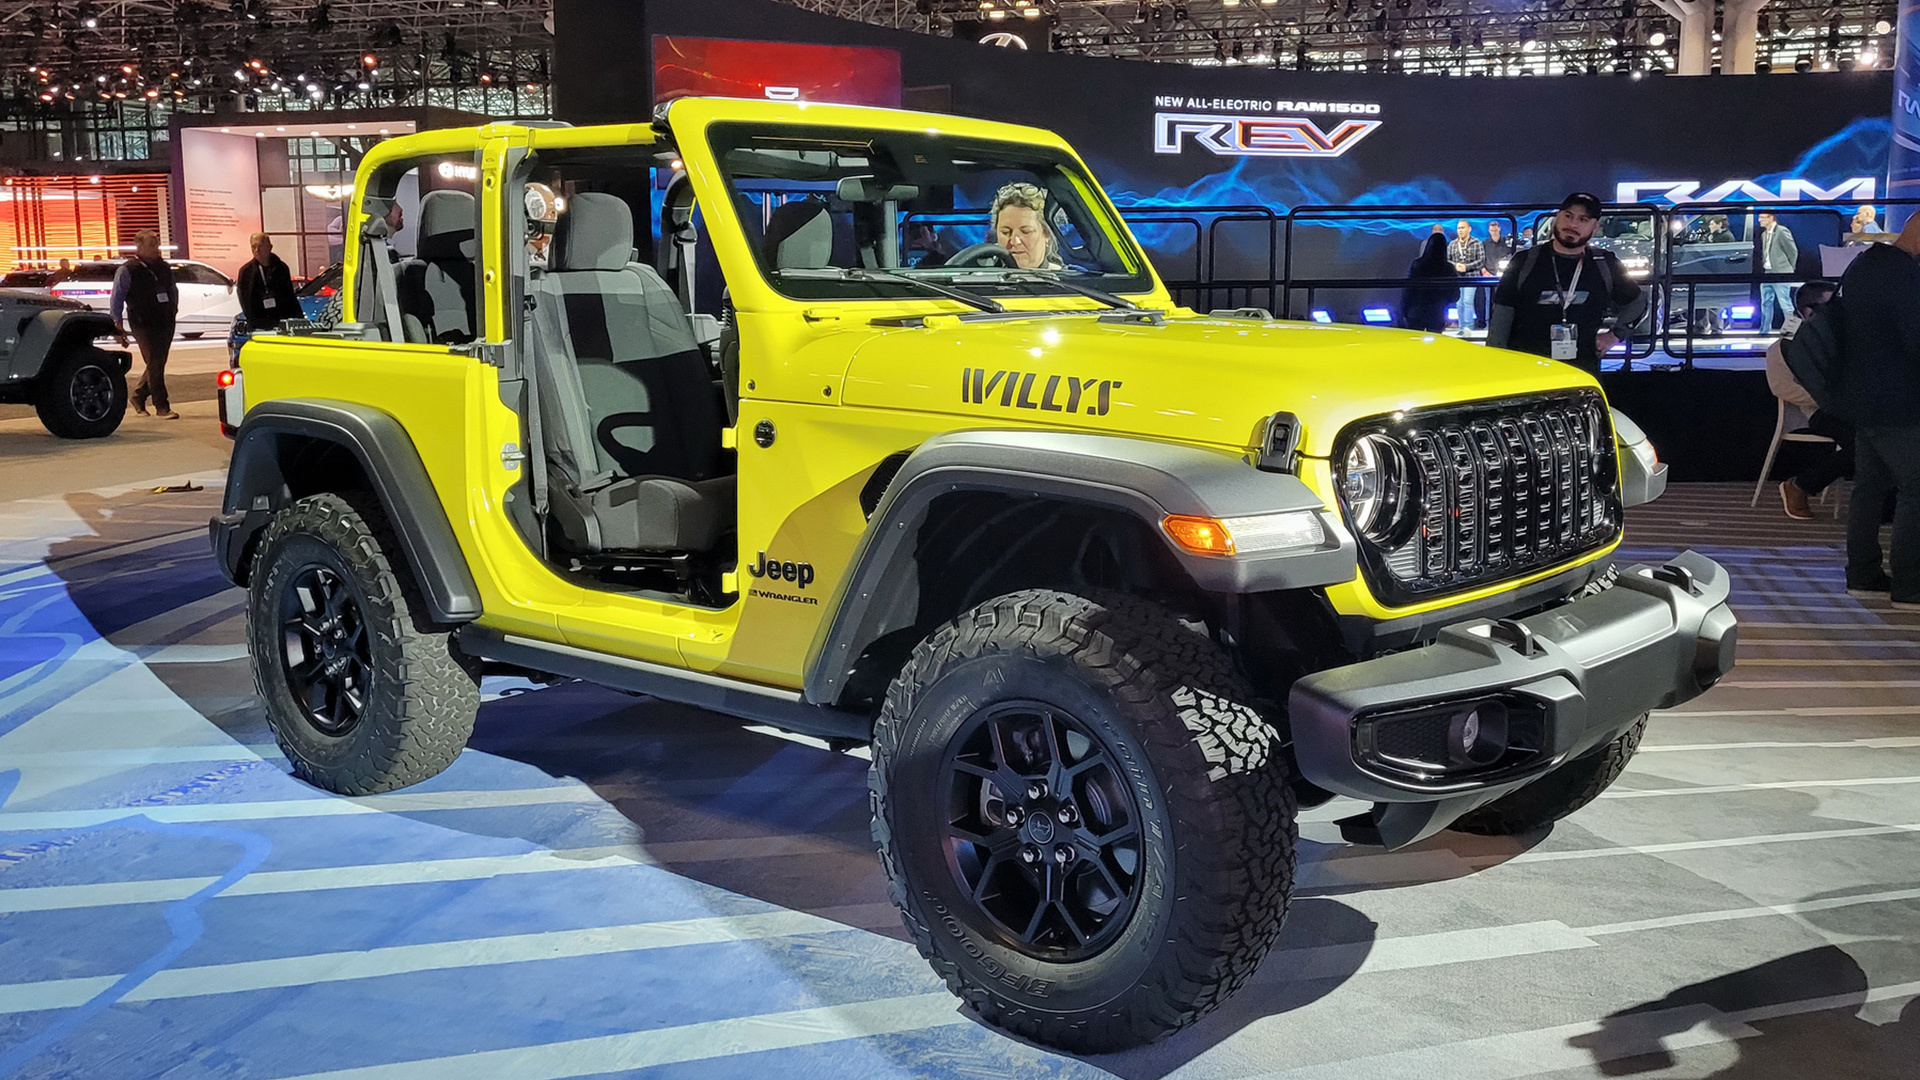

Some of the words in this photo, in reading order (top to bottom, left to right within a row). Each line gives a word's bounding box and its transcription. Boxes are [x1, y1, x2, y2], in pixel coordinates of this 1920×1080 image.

[1155, 96, 1184, 108] NEW
[1187, 98, 1272, 111] ALL-ELECTRIC
[1154, 113, 1383, 157] REV
[1616, 177, 1876, 203] RAM
[962, 367, 1123, 416] WILLYS
[748, 550, 815, 589] Jeep
[758, 590, 818, 606] WRANGLER
